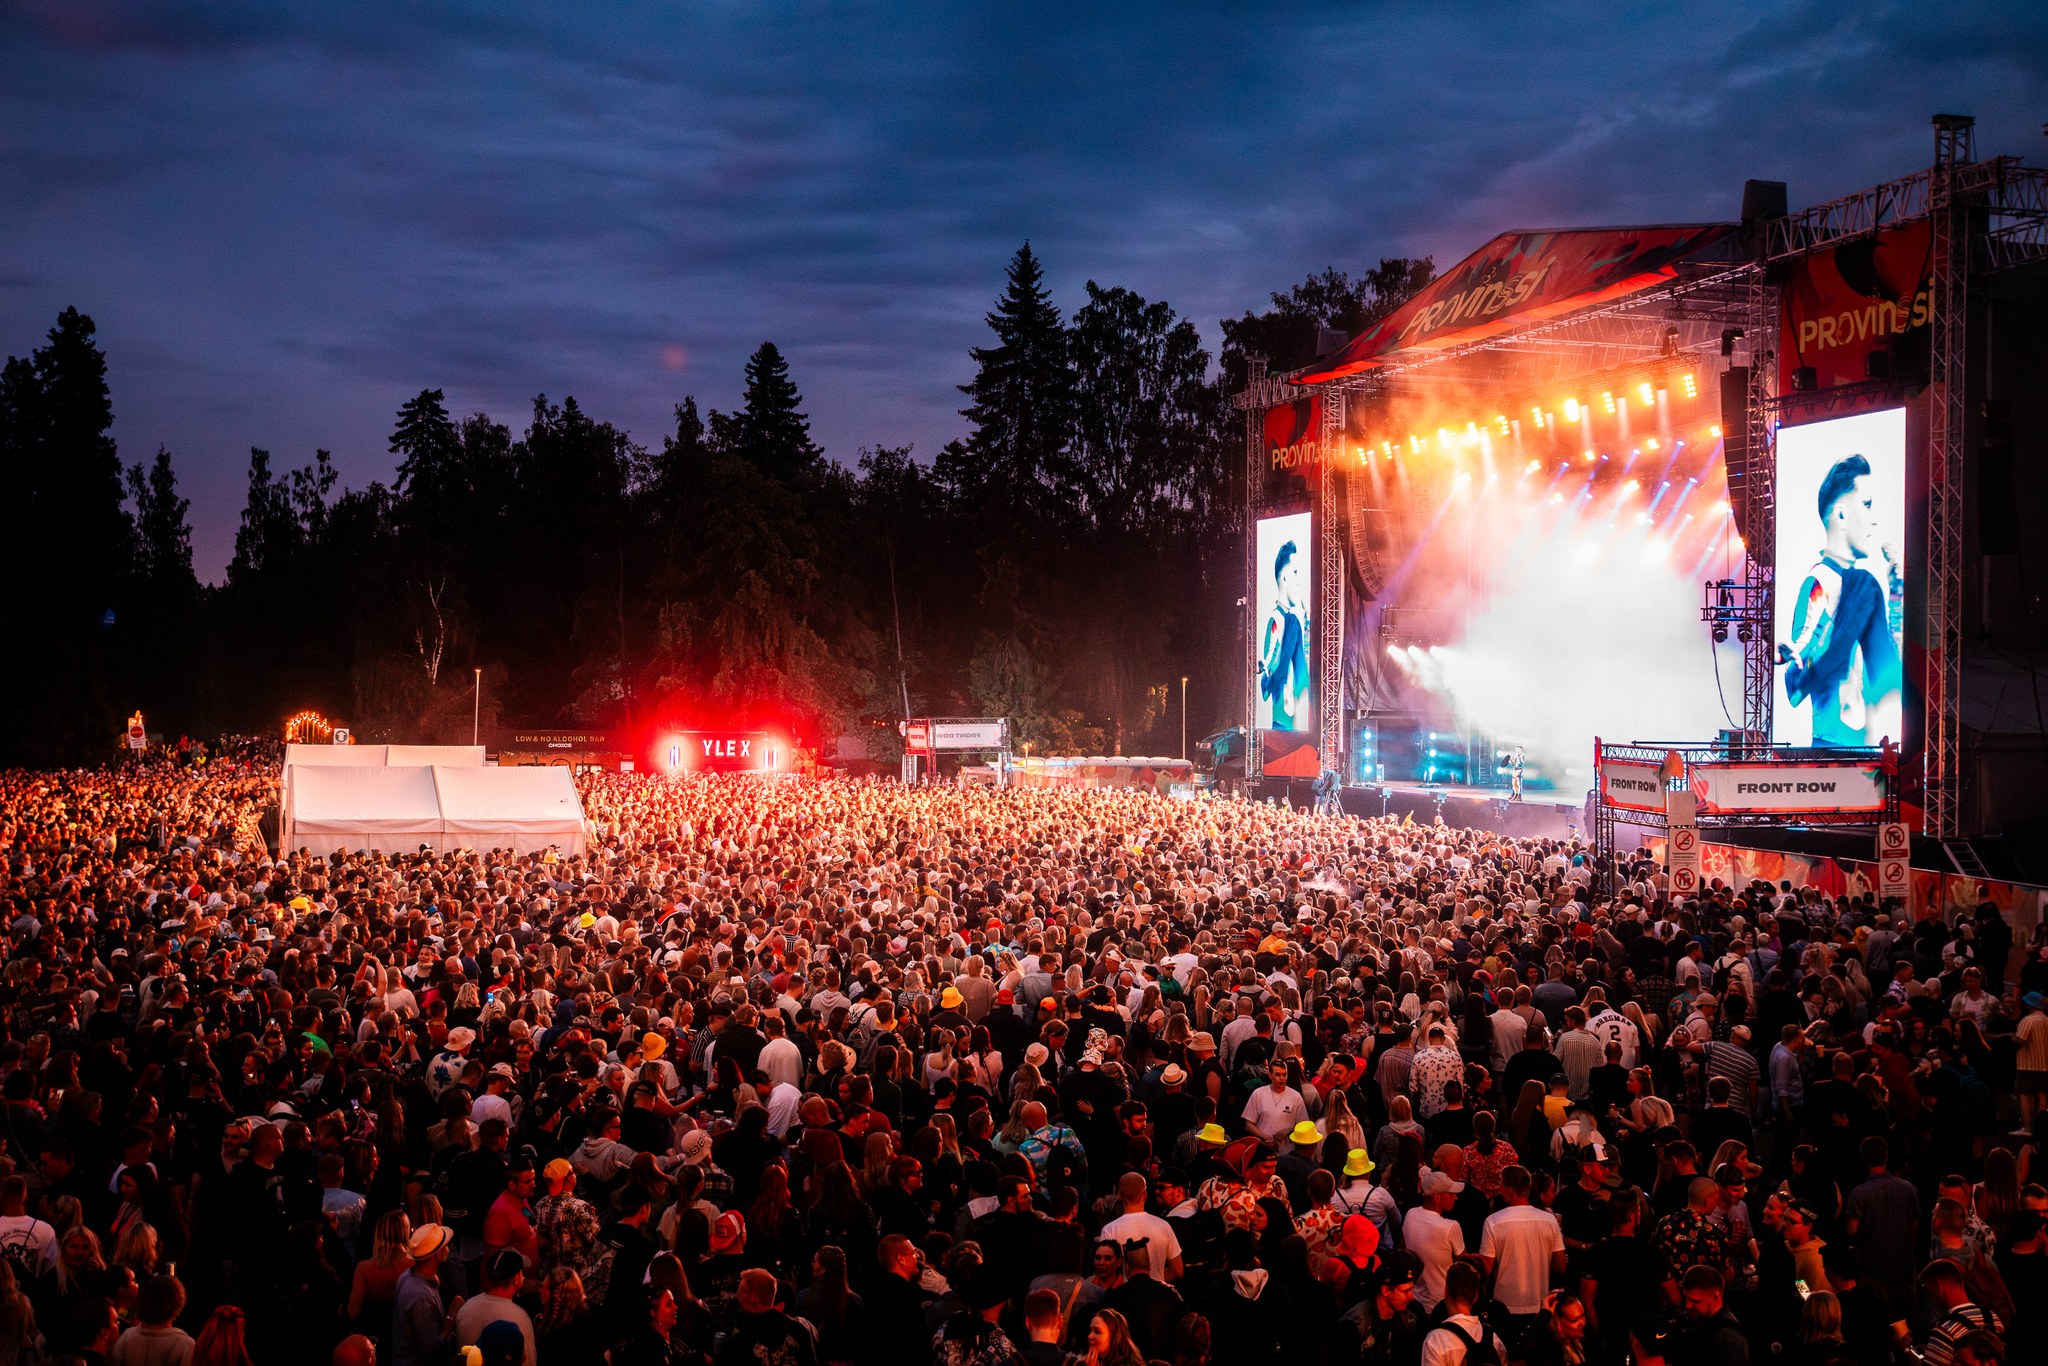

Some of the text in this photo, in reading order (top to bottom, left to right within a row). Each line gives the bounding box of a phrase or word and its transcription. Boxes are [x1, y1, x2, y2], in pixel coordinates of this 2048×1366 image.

[1611, 778, 1657, 792] FRONT ROW
[1737, 781, 1837, 794] FRONT ROW
[1609, 1025, 1622, 1042] 2
